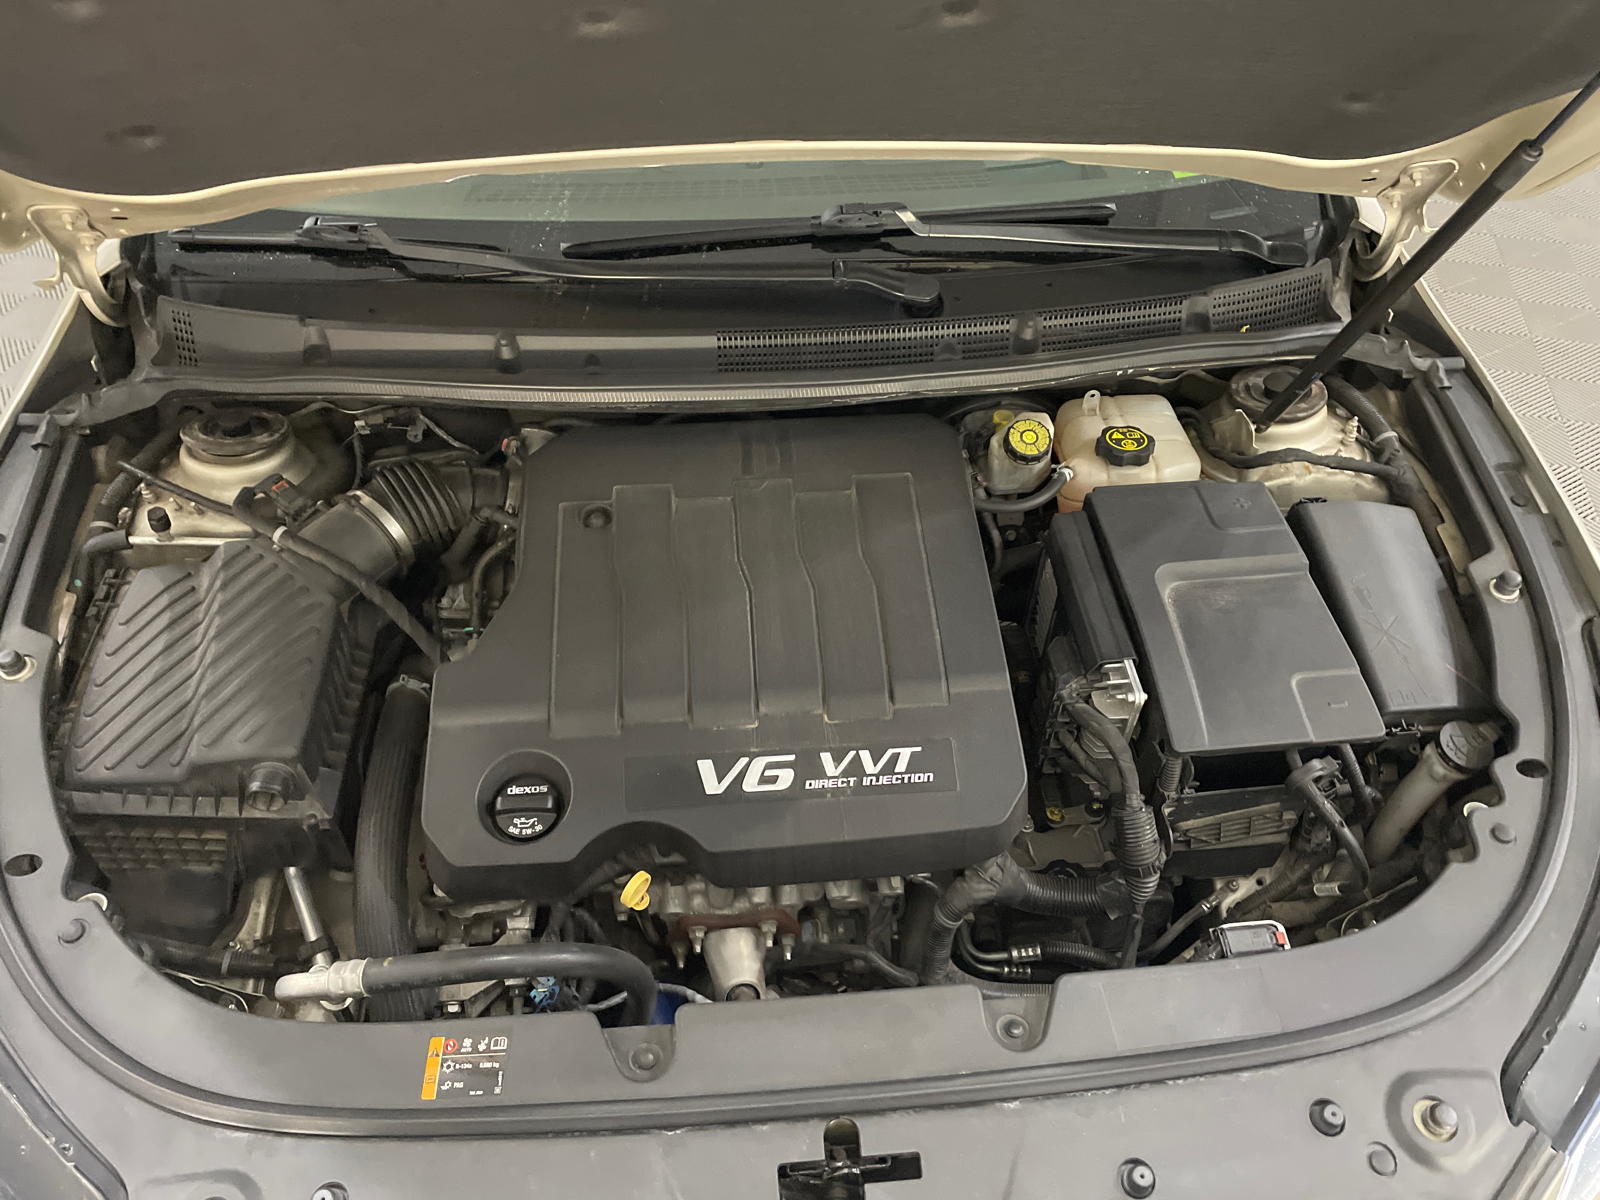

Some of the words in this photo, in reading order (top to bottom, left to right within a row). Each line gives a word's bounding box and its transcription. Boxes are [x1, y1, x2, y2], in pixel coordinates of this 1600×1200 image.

[819, 746, 922, 777] VVT
[696, 753, 796, 795] V6
[805, 777, 857, 790] DIRECT
[862, 772, 934, 786] INJECTION
[506, 785, 549, 795] dexos
[507, 825, 520, 835] SAE
[521, 824, 543, 835] 5W-30
